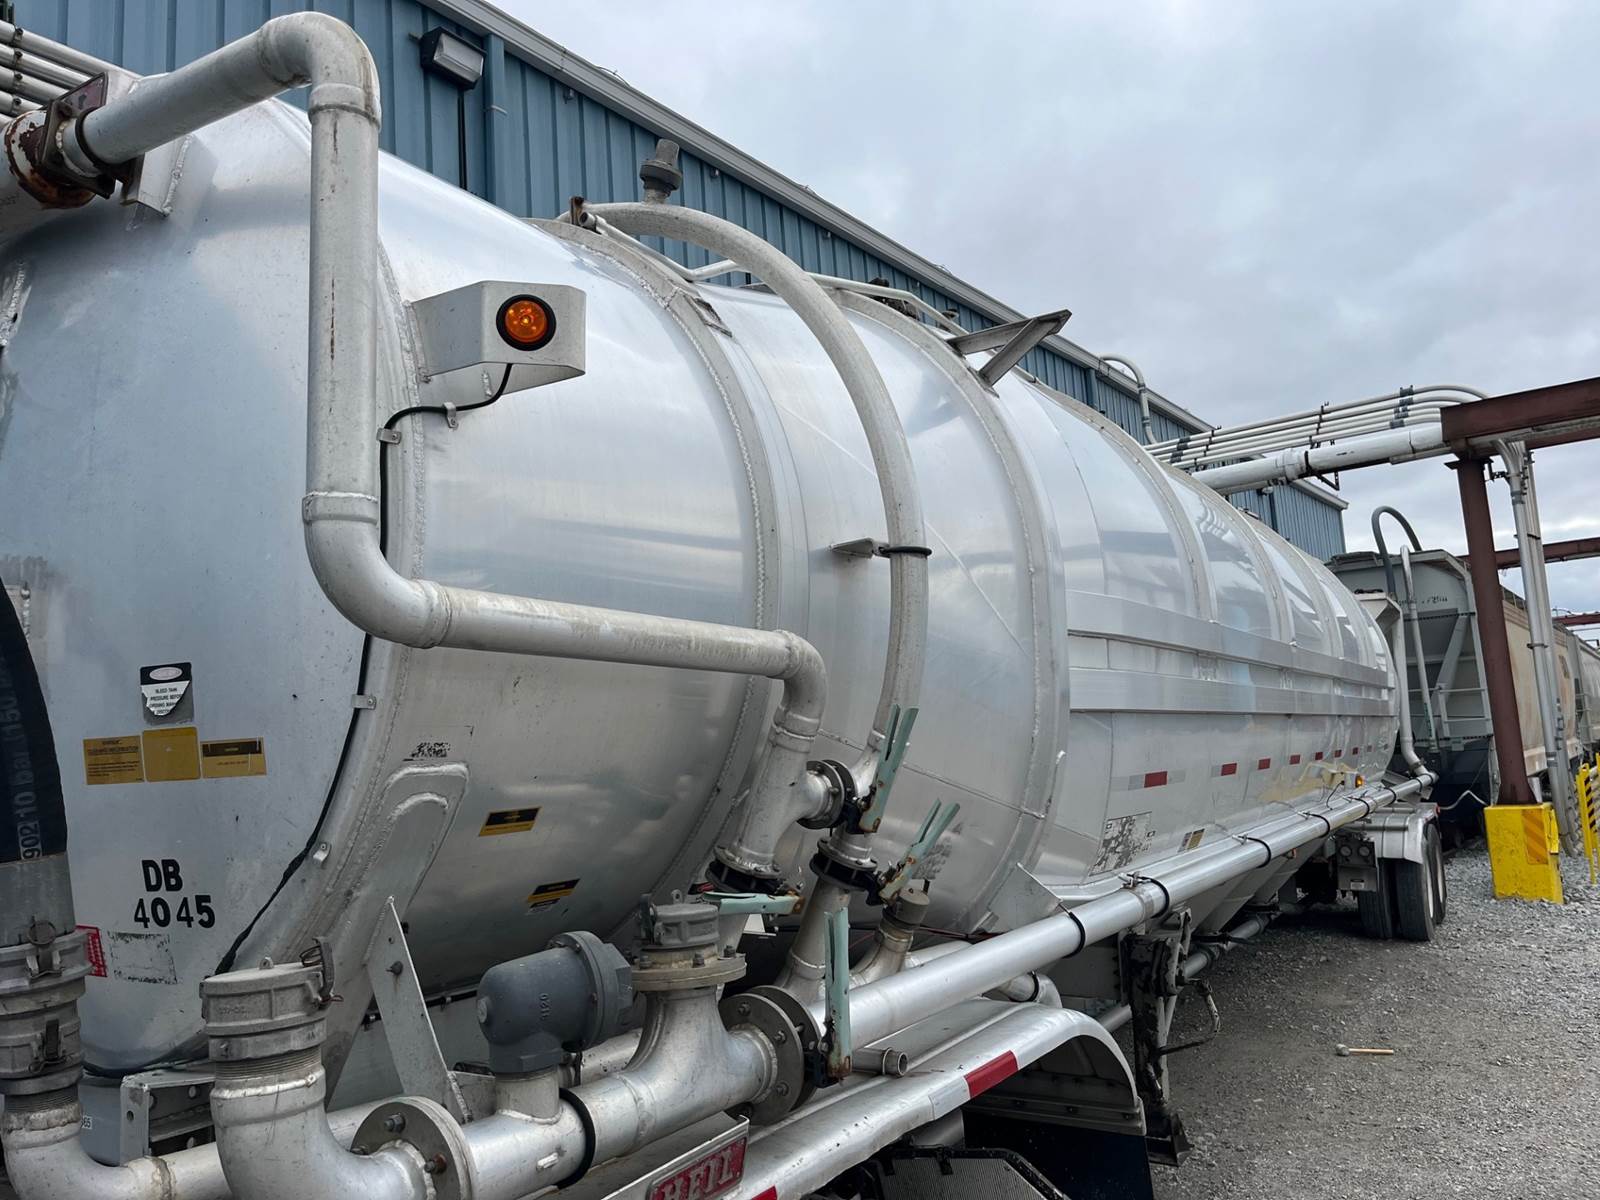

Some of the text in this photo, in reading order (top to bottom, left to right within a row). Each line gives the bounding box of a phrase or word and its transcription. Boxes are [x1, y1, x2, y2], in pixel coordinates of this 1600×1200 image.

[11, 752, 35, 786] bar
[14, 792, 37, 818] 10
[19, 822, 42, 859] 902
[142, 859, 183, 892] DB
[134, 895, 215, 928] 4045
